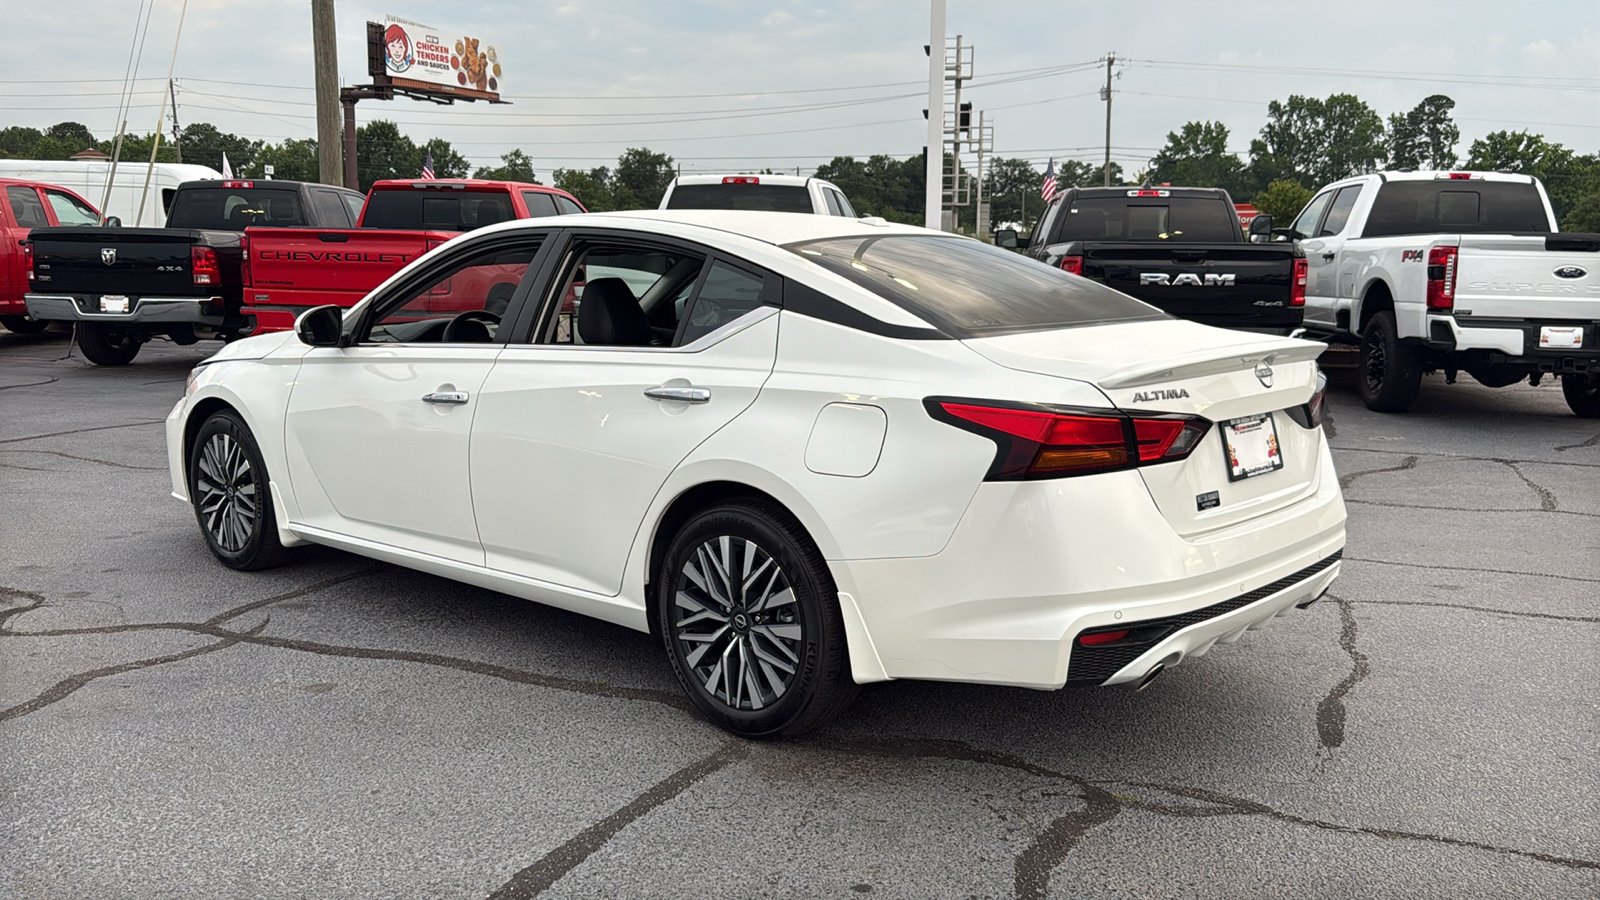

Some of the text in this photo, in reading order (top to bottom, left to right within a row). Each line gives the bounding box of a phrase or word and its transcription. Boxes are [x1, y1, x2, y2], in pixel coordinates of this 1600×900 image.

[416, 41, 449, 54] CHICKEN
[416, 50, 449, 63] TENDERS
[417, 59, 450, 71] AND SAUCES
[260, 251, 412, 263] CHEVROLET
[1402, 249, 1424, 263] FX4
[1139, 273, 1236, 286] RAM
[1468, 281, 1578, 293] SUPER
[1133, 388, 1190, 403] ALTIMA
